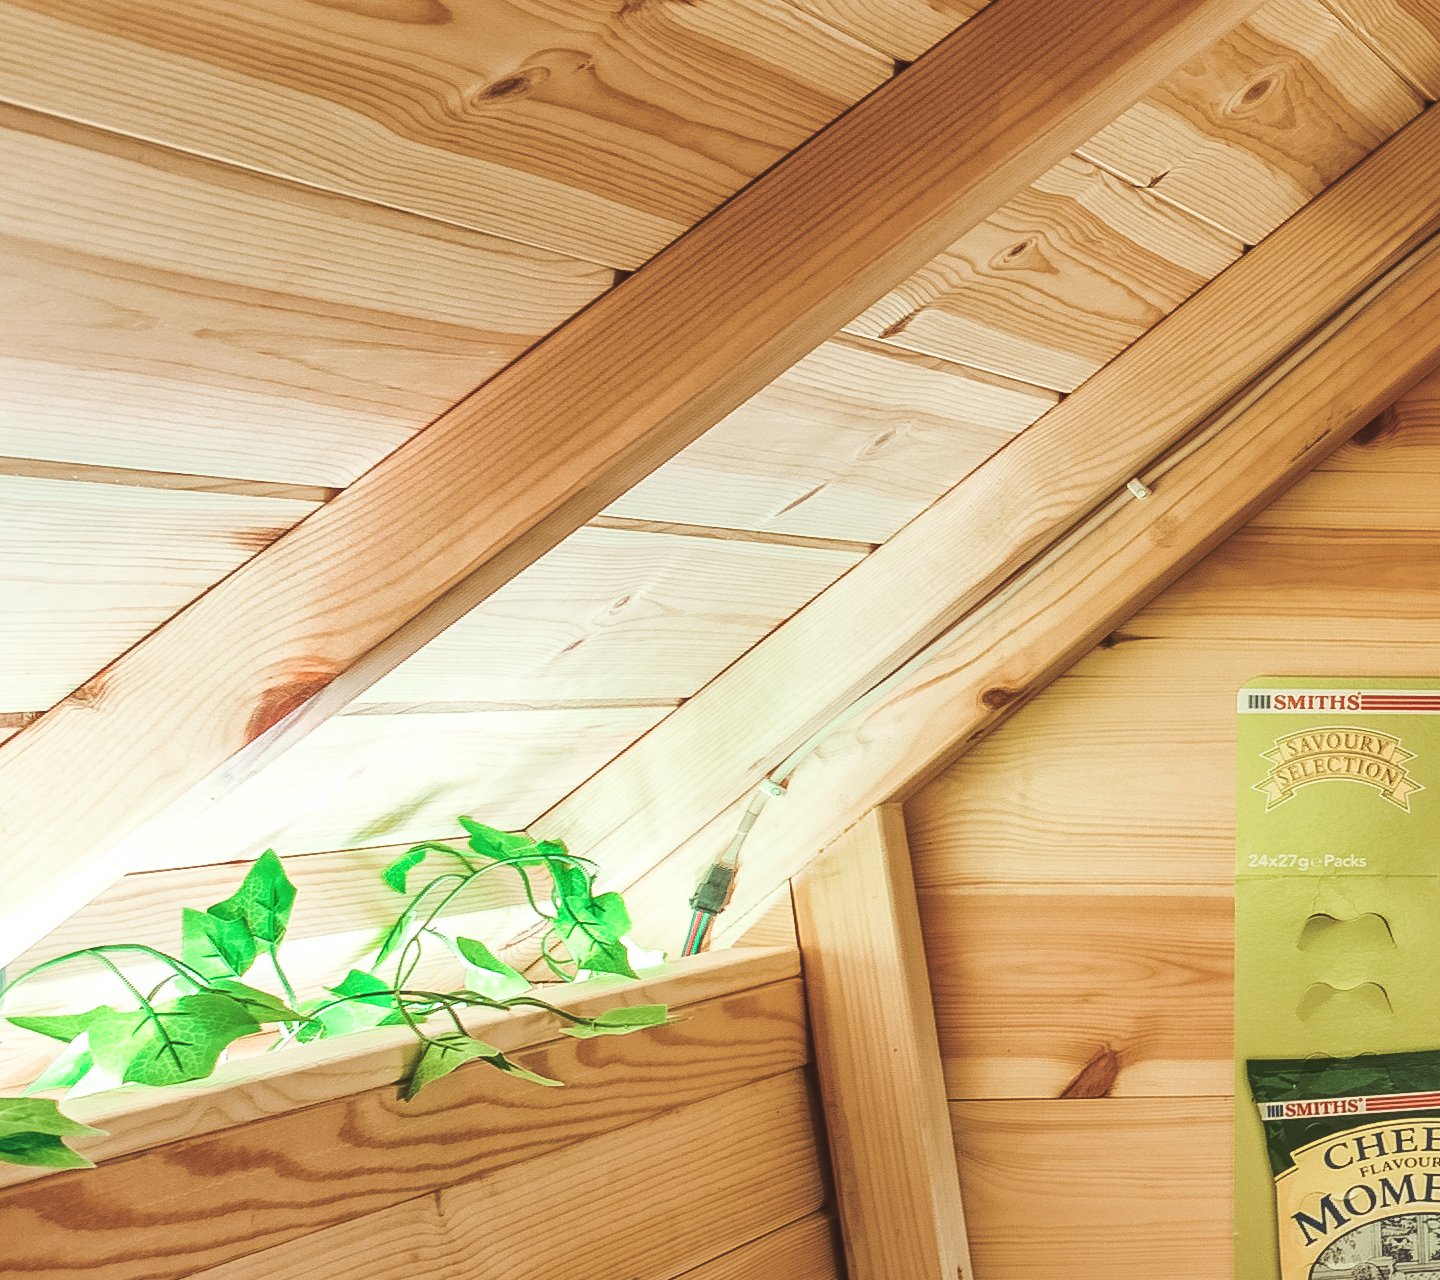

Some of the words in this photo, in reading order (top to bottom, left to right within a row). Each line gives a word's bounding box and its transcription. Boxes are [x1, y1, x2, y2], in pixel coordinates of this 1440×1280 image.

[1286, 733, 1389, 757] SAVOURY
[1276, 756, 1399, 786] SELECTION
[1324, 854, 1366, 868] Packs
